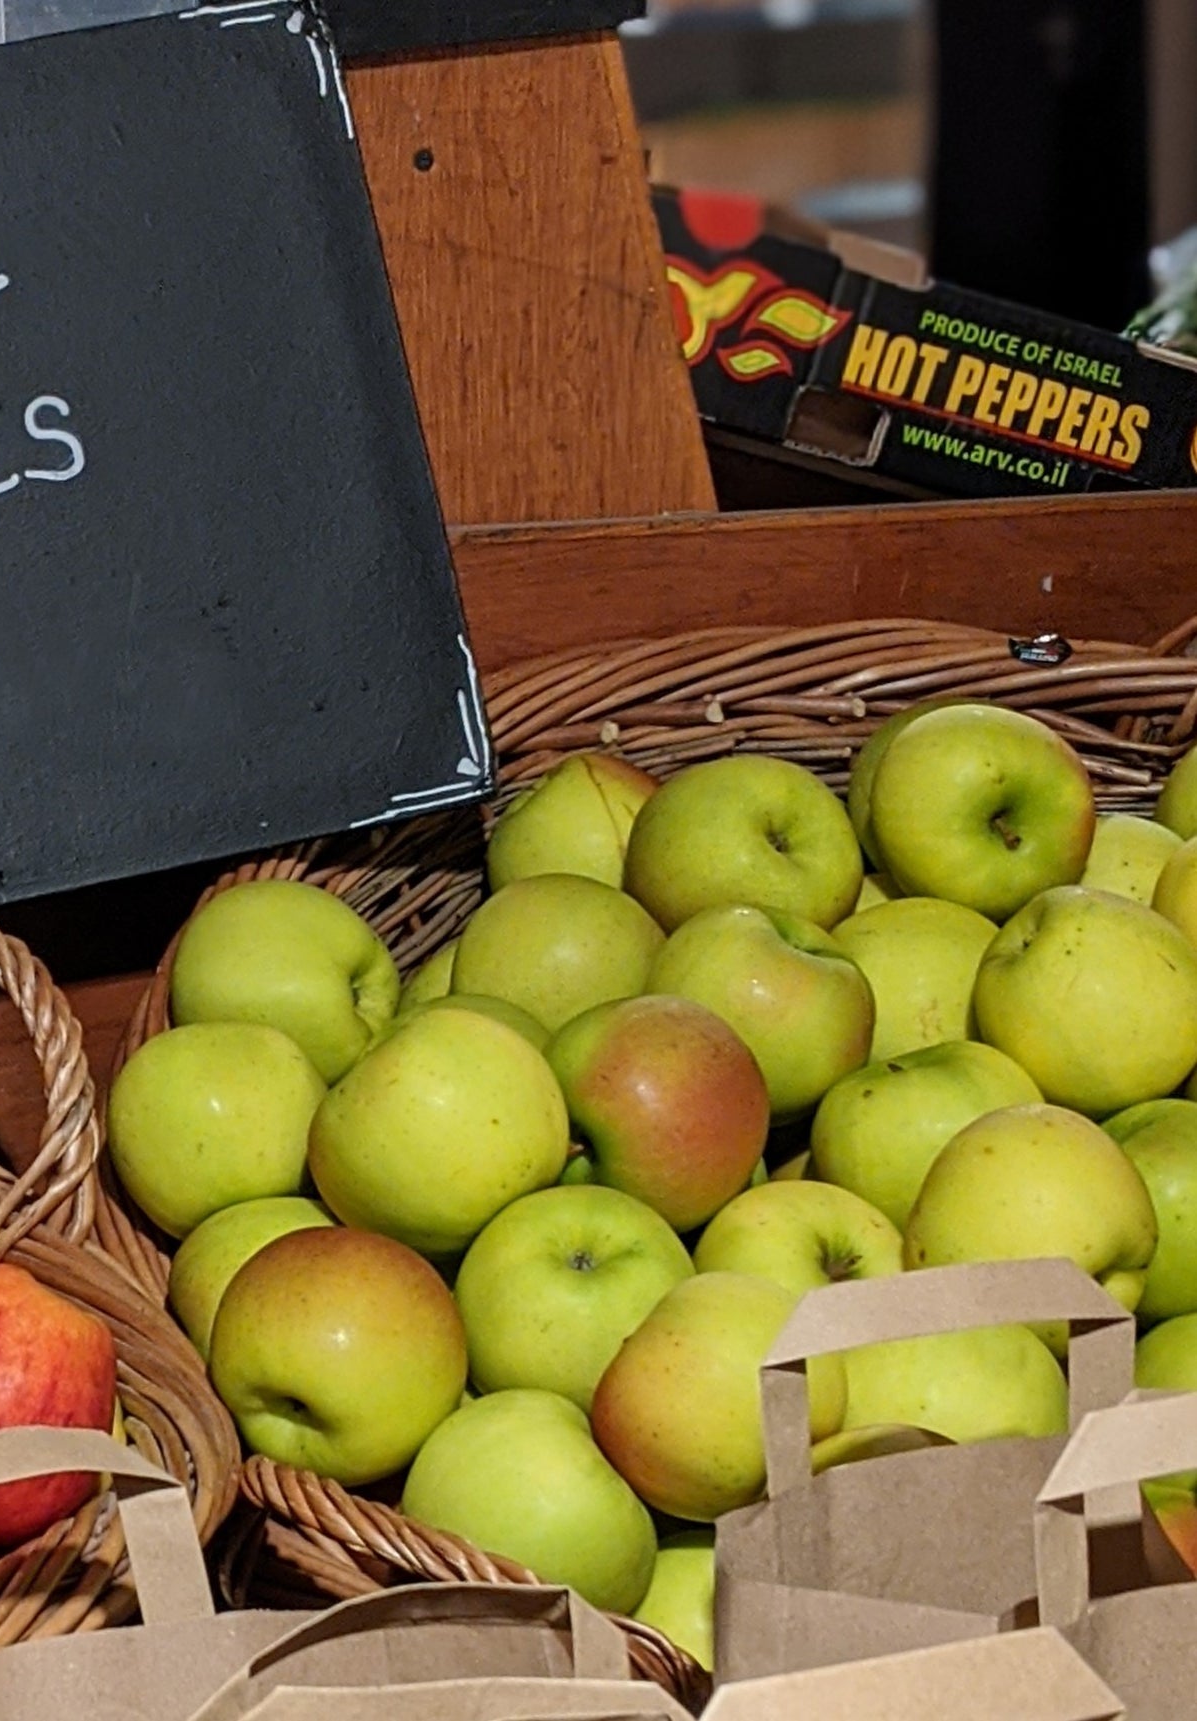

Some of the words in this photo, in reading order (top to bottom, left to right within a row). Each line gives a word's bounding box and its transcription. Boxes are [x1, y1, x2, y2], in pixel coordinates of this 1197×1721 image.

[918, 310, 1021, 358] PRODUCE
[1022, 340, 1053, 365] OF
[1053, 349, 1123, 389] ISRAEL
[841, 324, 950, 405] HOT
[944, 354, 1151, 466] PEPPERS
[902, 424, 1071, 488] www.arv.co.il
